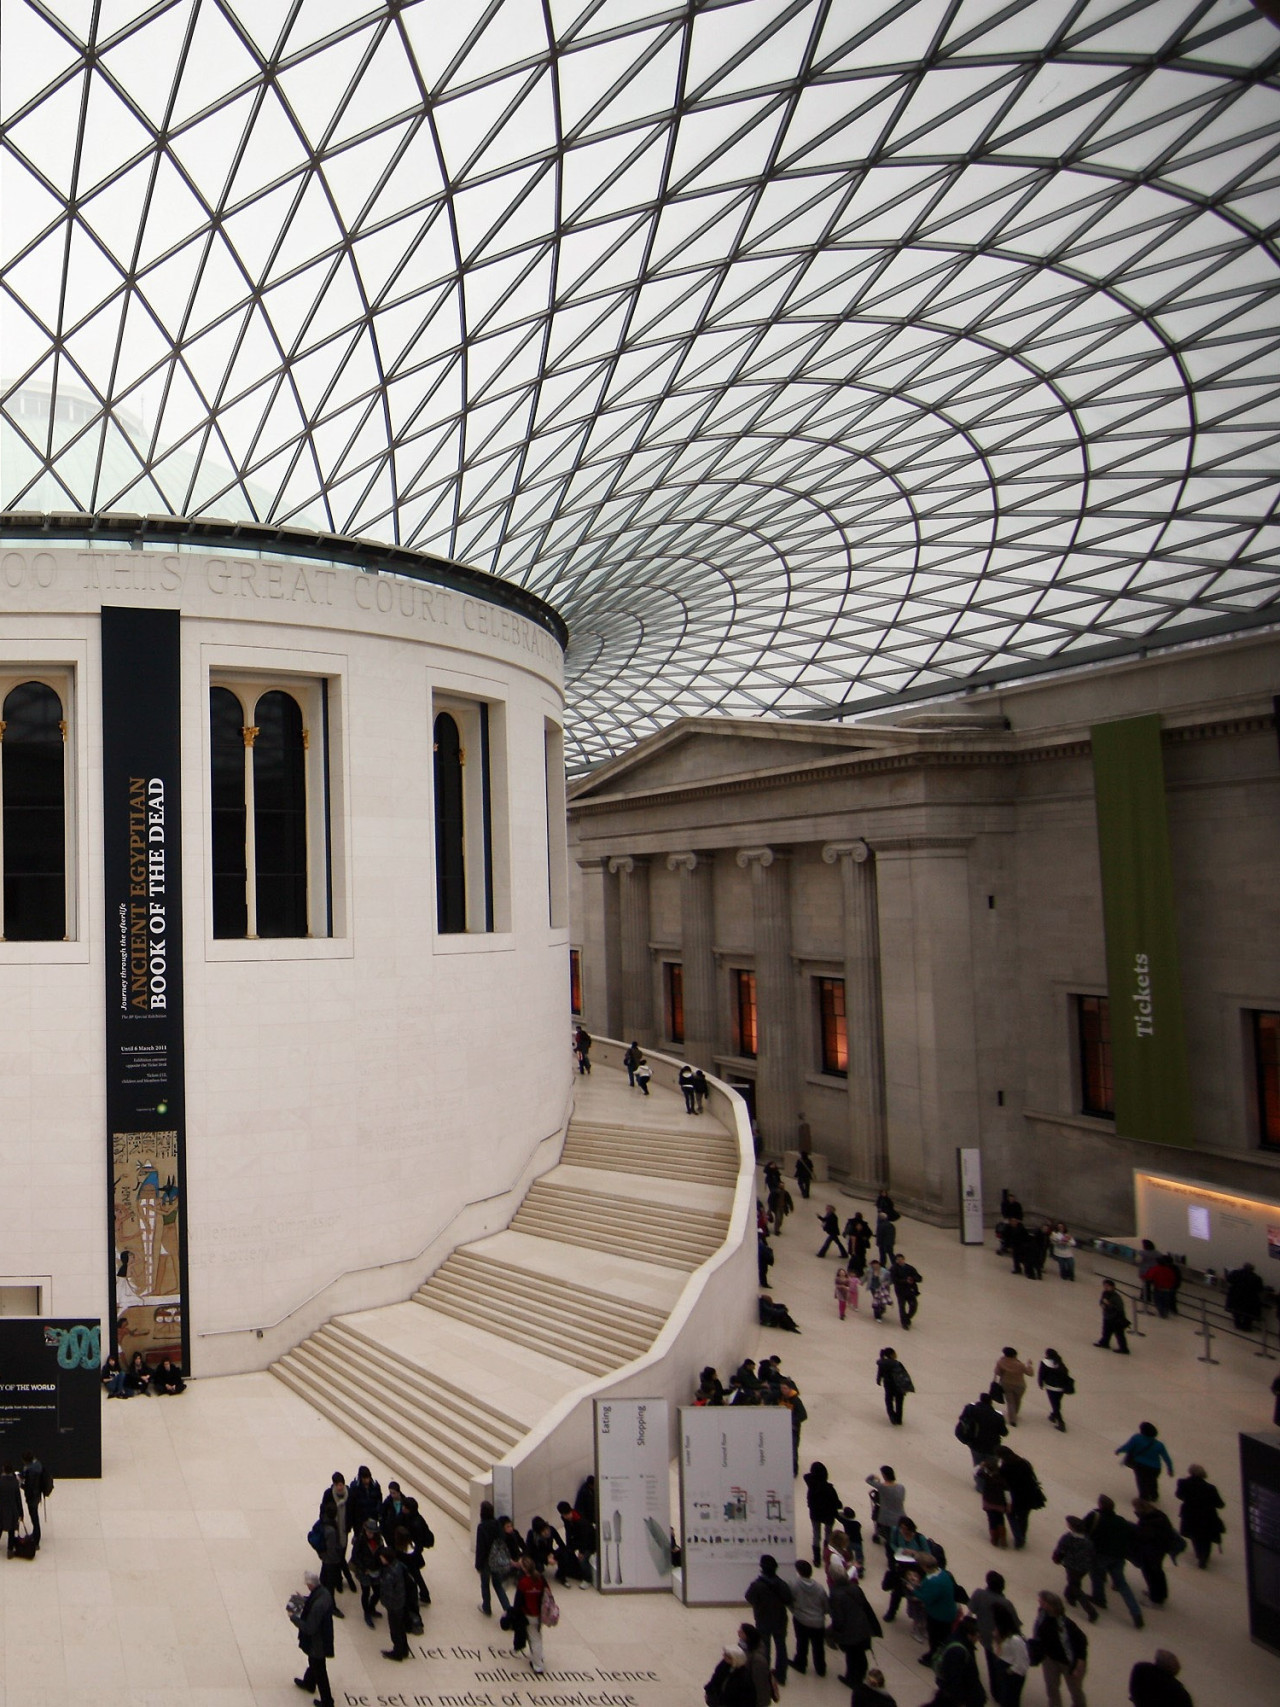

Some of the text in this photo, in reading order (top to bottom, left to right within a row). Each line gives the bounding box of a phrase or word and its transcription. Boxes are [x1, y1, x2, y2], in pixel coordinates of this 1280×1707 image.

[76, 553, 183, 592] THIS
[207, 558, 337, 606] GREAT
[353, 574, 454, 626] COURT
[129, 776, 148, 1010] ANCIENT EGYPTIAN
[148, 777, 166, 1010] BOOK OF THE DEAD
[118, 903, 126, 934] afterlife
[119, 948, 128, 978] through
[119, 980, 128, 1010] Journey
[1132, 953, 1153, 1038] Tickets
[602, 1406, 612, 1434] Eating
[637, 1405, 647, 1446] Shopping
[419, 1646, 446, 1659] let
[451, 1646, 482, 1662] thy
[598, 1667, 662, 1682] hence
[344, 1691, 370, 1707] be
[377, 1692, 407, 1707] set
[414, 1693, 433, 1707] in
[438, 1691, 495, 1707] midst
[501, 1691, 524, 1707] of
